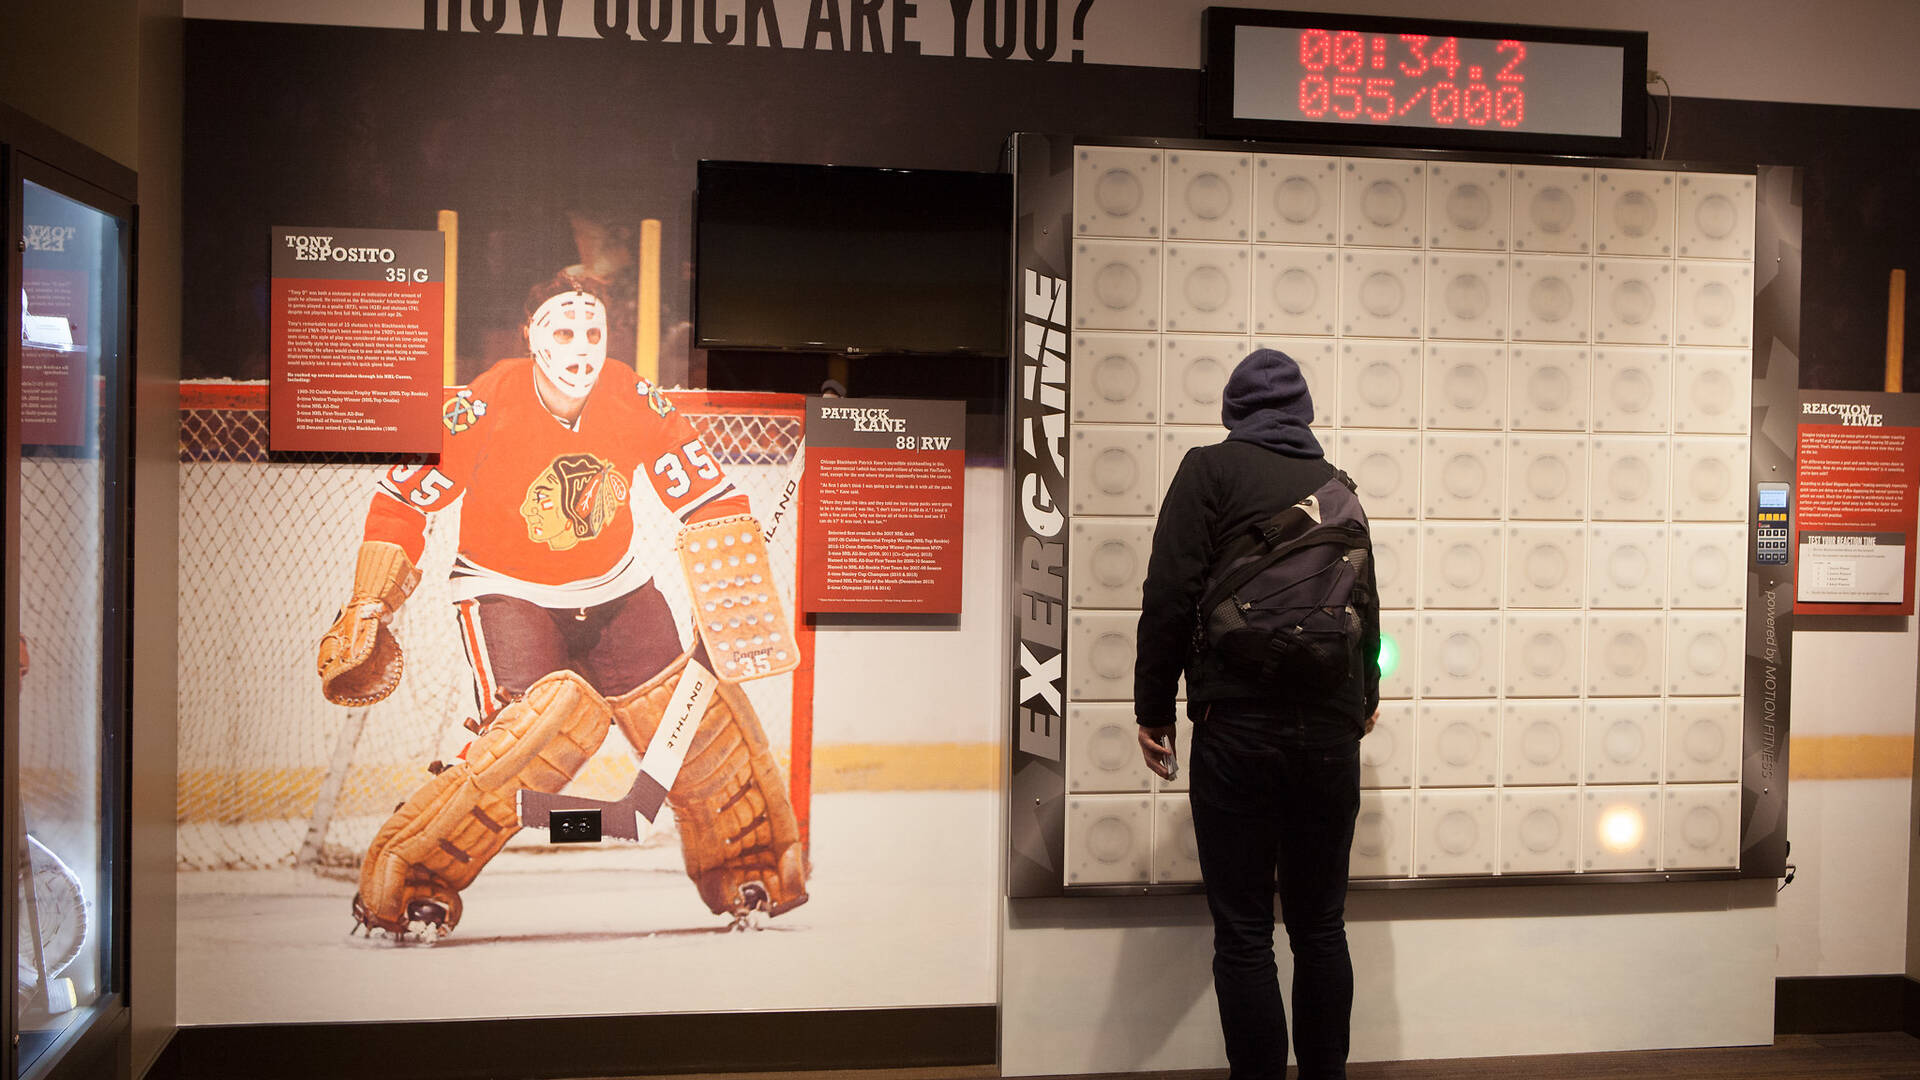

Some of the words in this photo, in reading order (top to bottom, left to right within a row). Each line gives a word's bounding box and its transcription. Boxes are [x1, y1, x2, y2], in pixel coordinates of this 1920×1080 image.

[1302, 29, 1526, 82] 00:34.2
[1299, 75, 1525, 128] 055/000
[286, 236, 333, 249] TONY
[296, 247, 395, 263] ESPOSITO
[821, 407, 889, 420] PATRICK
[1802, 403, 1871, 415] REACTION
[1841, 414, 1883, 427] TIME
[853, 418, 906, 432] KANE
[654, 439, 719, 498] 35
[1019, 268, 1067, 762] EXERGAME
[1765, 591, 1776, 647] powered
[739, 654, 772, 677] 35
[1764, 649, 1776, 663] by
[1764, 667, 1776, 721] MOTION
[1762, 724, 1775, 779] FITNESS
